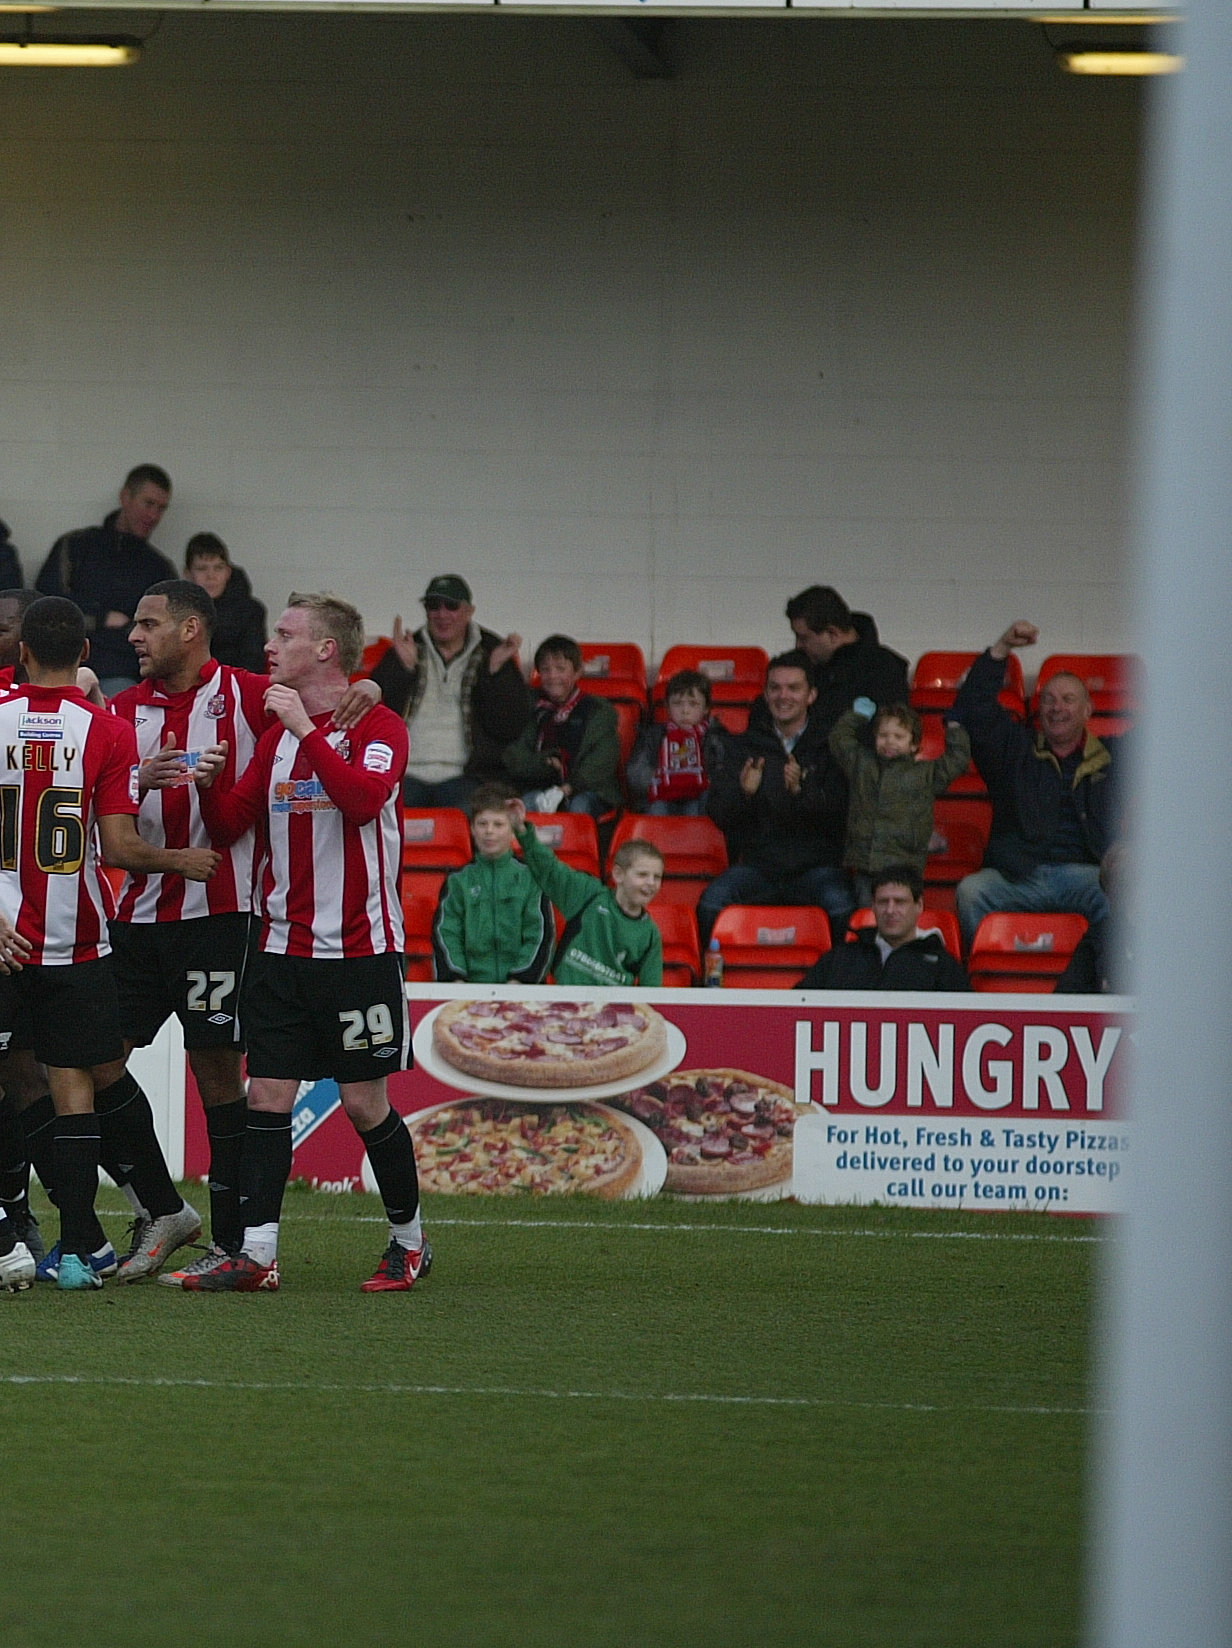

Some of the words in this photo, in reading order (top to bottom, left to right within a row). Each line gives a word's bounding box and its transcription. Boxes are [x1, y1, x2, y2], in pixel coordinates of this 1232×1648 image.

[6, 744, 76, 772] KELLY
[186, 970, 236, 1012] 27
[338, 1003, 394, 1051] 29
[794, 1020, 1123, 1112] HUNGRY
[826, 1125, 859, 1144] For
[865, 1126, 908, 1149] Hot,
[916, 1127, 972, 1147] Fresh
[980, 1130, 996, 1148] &
[1002, 1129, 1059, 1154] Tasty
[1066, 1130, 1130, 1151] Pizzas
[836, 1152, 936, 1172] delivered
[944, 1155, 964, 1173] to
[971, 1159, 1021, 1178] your
[1025, 1156, 1121, 1180] doorstep
[887, 1179, 925, 1197] call
[931, 1182, 967, 1198] our
[973, 1181, 1027, 1199] team
[1034, 1186, 1069, 1201] on:
